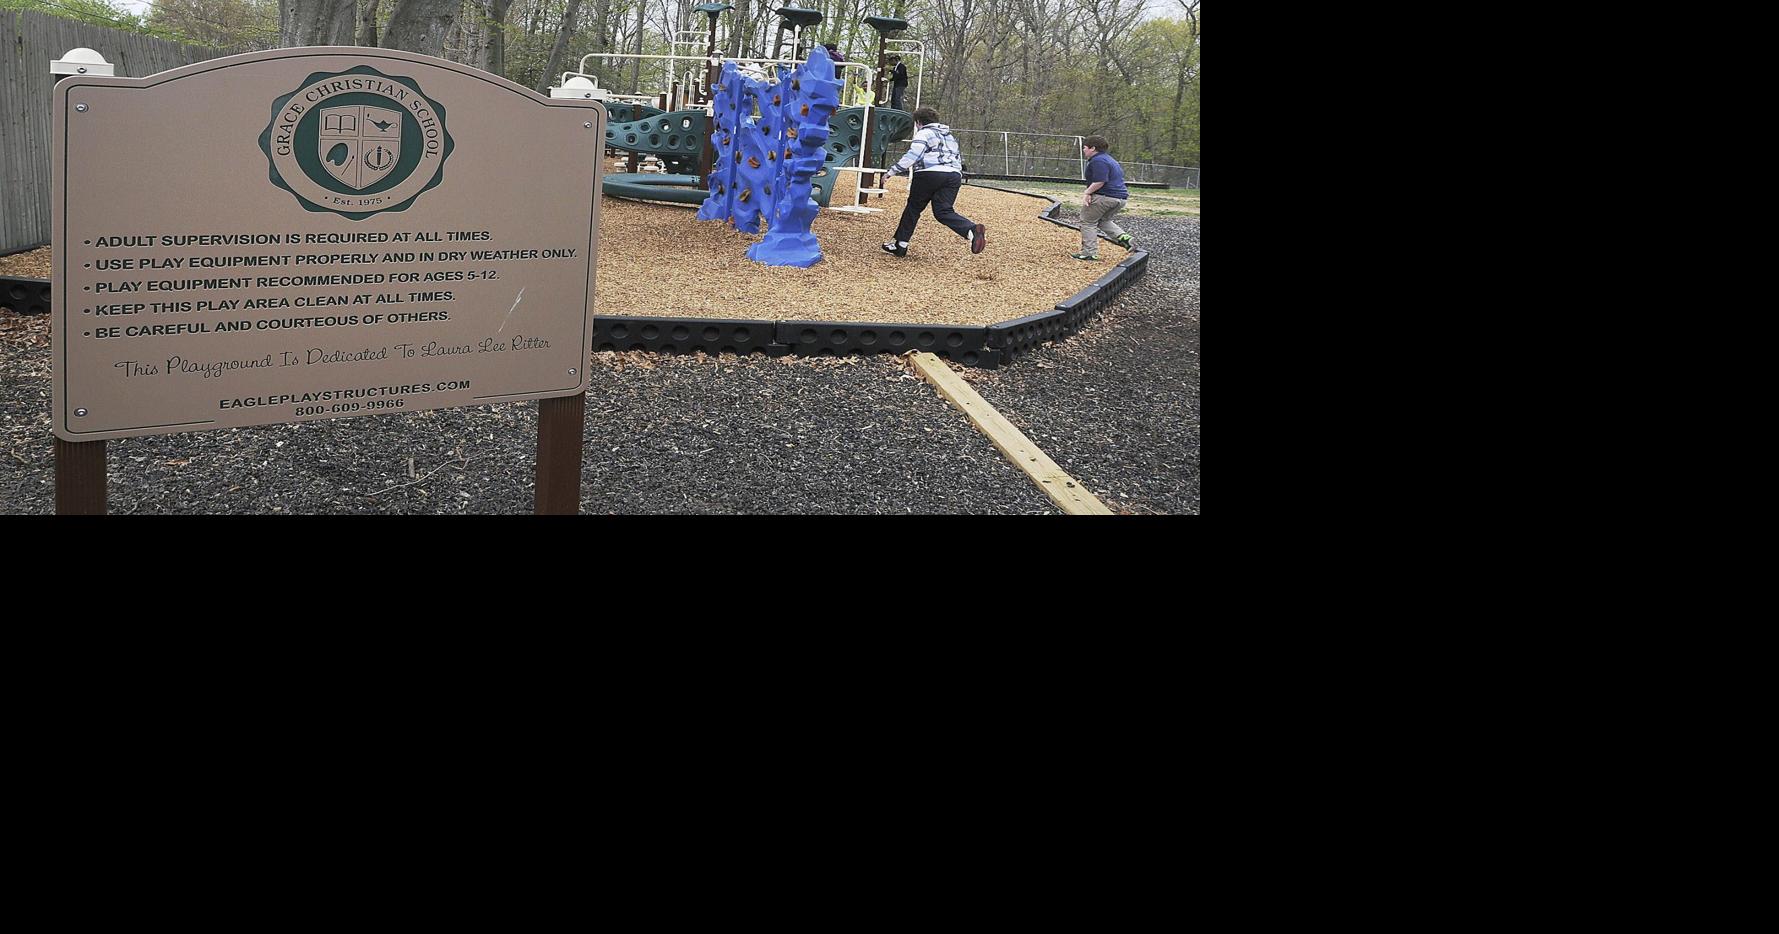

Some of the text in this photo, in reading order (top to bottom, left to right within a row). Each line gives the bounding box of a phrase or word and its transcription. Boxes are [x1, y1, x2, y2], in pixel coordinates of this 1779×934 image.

[277, 78, 439, 158] GRACE CHRISTIAN SCHOOL
[333, 197, 383, 206] Est. 1975
[95, 230, 493, 248] ADULT SUPERVISION IS REQUIRED AT ALL TIMES.
[96, 248, 578, 270] USE PLAY EQUIPMENT PROPERLY AND IN DRY WEATHER ONLY.
[95, 270, 500, 294] PLAY EQUIPMENT RECOMMENDED FOR AGES 5-12.
[95, 291, 456, 316] KEEP THIS PLAY AREA CLEAN AT ALL TIMES.
[95, 311, 451, 339] BE CAREFUL AND COURTEOUS OF OTHERS.
[114, 334, 552, 379] This Playground Is Dedicated To Laura Lee Ritter
[219, 380, 470, 409] EAGLEPLAYSTRUCTURES.COM
[295, 399, 404, 417] 800-609-9966
